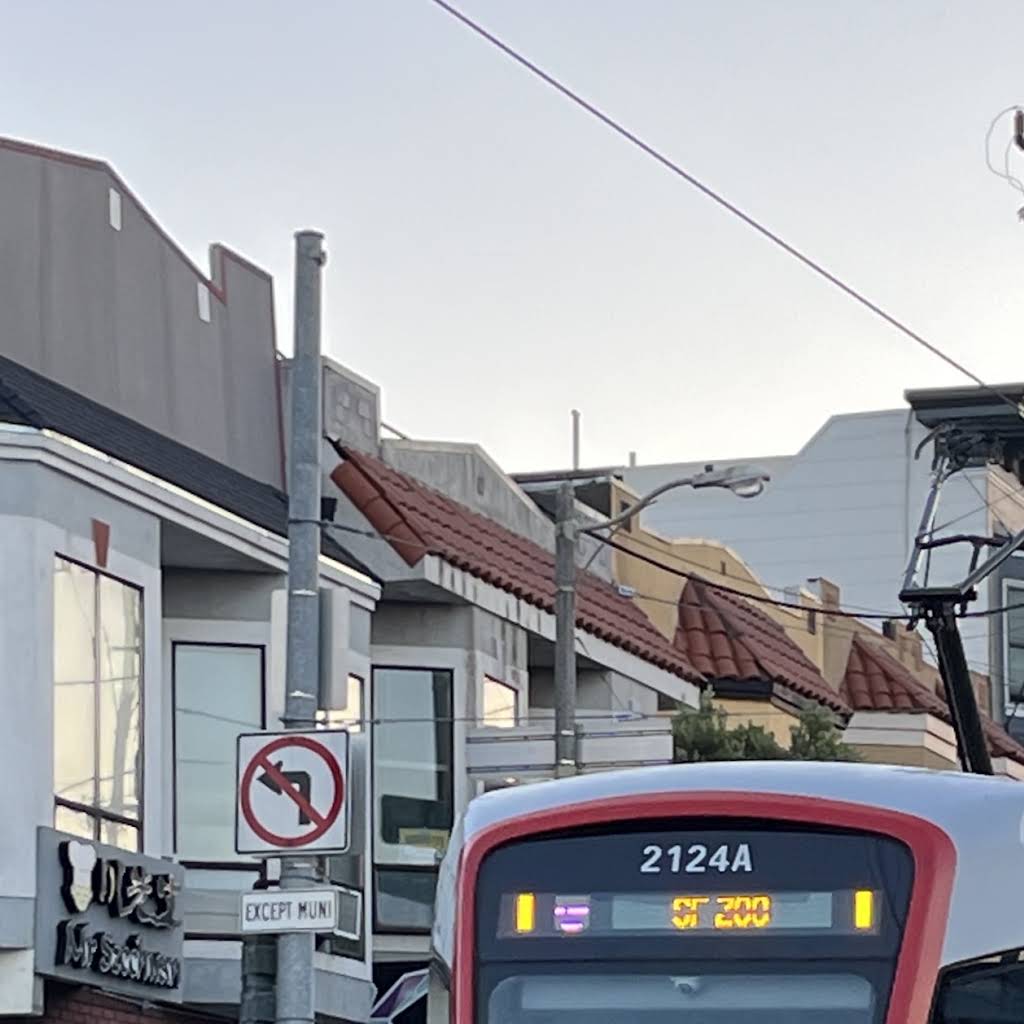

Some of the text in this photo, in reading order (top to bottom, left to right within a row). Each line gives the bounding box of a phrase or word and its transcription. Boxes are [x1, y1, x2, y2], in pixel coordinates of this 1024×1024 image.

[640, 844, 752, 872] 2124A
[245, 901, 333, 921] EXCEPT MUNI
